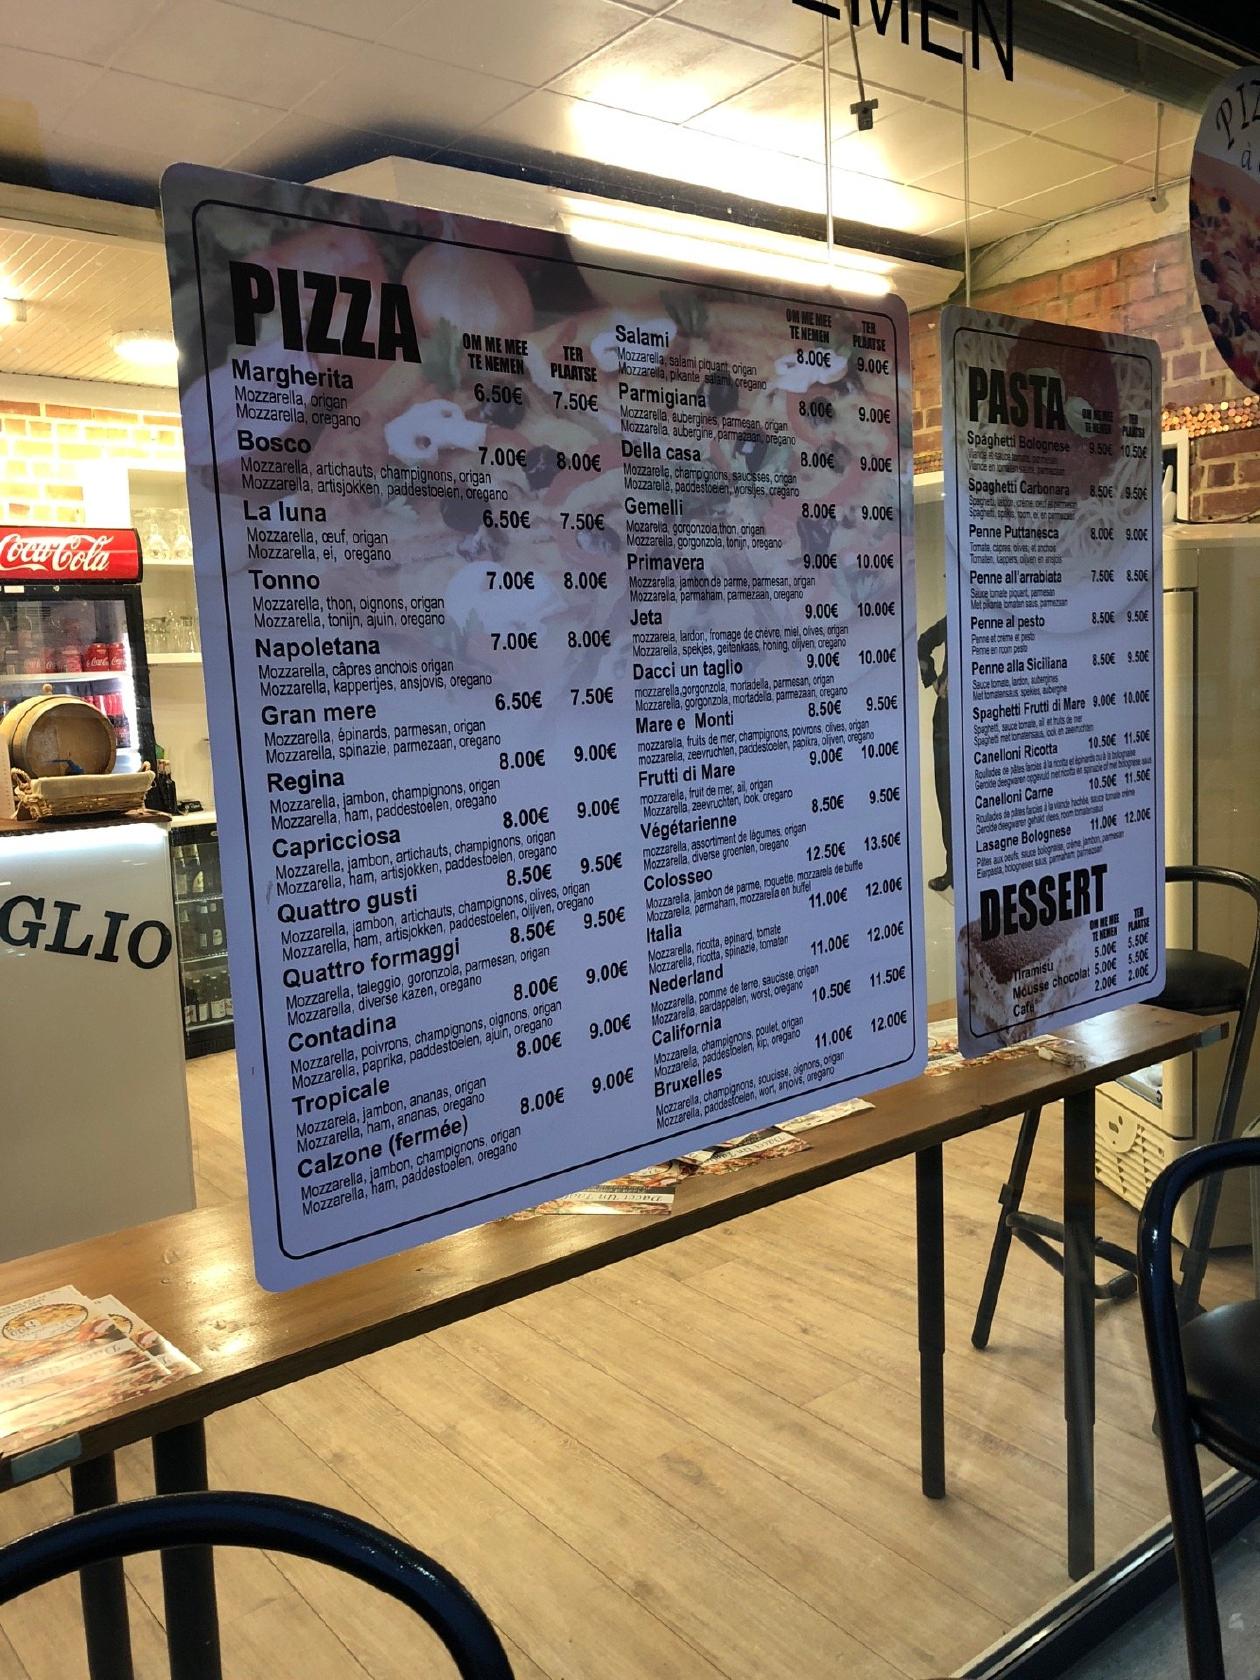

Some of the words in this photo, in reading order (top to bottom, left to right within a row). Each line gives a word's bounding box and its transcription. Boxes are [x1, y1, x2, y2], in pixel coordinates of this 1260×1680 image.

[229, 261, 422, 363] PIZZA
[462, 333, 482, 350] OM
[485, 336, 502, 353] ME
[505, 339, 528, 356] MEE
[616, 325, 669, 348] Salami
[468, 354, 482, 370] TE
[485, 356, 524, 374] NEMEN
[563, 346, 583, 362] TER
[796, 348, 831, 368] 8.00€
[857, 357, 889, 375] 9.00€
[232, 359, 353, 389] Margherita
[550, 363, 597, 382] PLAATSE
[474, 383, 522, 405] 6.50€
[553, 391, 598, 412] 7.50€
[619, 382, 706, 409] Parmigiana
[968, 366, 1066, 430] PASTA
[238, 430, 312, 453] Bosco
[622, 440, 660, 458] Della
[666, 446, 700, 461] casa
[968, 430, 1016, 448] Spaghetti
[478, 446, 527, 467] 7.00€
[556, 452, 601, 472] 8.00€
[968, 478, 1016, 496] Spaghetti
[1020, 480, 1070, 496] Carbonara
[244, 500, 271, 521] La
[279, 501, 327, 522] luna
[624, 496, 683, 515] Gemelli
[802, 503, 836, 519] 8.00€
[862, 505, 894, 520] 9.00€
[246, 527, 318, 544] Mozzarella,
[352, 530, 388, 548] origan
[969, 524, 1000, 538] Penne
[1004, 525, 1059, 540] Puttanesca
[627, 553, 704, 570] Primavera
[804, 554, 838, 569] 9.00€
[856, 554, 894, 569] 10.00€
[248, 570, 320, 590] Tonno
[486, 571, 534, 590] 7.00€
[563, 572, 608, 590] 8.00€
[970, 570, 1002, 584] Penne
[630, 609, 662, 626] Jeta
[970, 616, 1004, 630] Penne
[1006, 615, 1014, 628] al
[1018, 615, 1045, 631] pesto
[255, 636, 380, 662] Napoletana
[490, 632, 538, 650] 7.00€
[568, 630, 612, 648] 8.00€
[258, 662, 328, 680] Mozzarella,
[374, 660, 418, 676] anchois
[421, 659, 454, 675] origan
[633, 662, 676, 680] Dacci
[680, 664, 698, 677] un
[703, 659, 743, 678] taglio
[972, 661, 1004, 676] Penne
[1007, 659, 1024, 672] alla
[1026, 656, 1068, 670] Siciliana
[260, 680, 330, 697] Mozzarella,
[450, 674, 492, 690] oregano
[494, 690, 542, 710] 6.50€
[570, 687, 614, 706] 7.50€
[808, 700, 842, 718] 8.50€
[866, 695, 898, 712] 9.50€
[972, 702, 1020, 722] Spaghetti
[1024, 700, 1049, 715] Frutti
[1052, 700, 1061, 712] di
[1064, 697, 1086, 710] Mare
[1093, 693, 1116, 708] 9.00€
[1123, 690, 1150, 704] 10.00€
[261, 706, 316, 726] Gran
[324, 704, 376, 722] mere
[636, 718, 672, 734] Mare
[677, 718, 686, 730] e
[694, 710, 734, 728] Monti
[500, 749, 546, 770] 8.00€
[574, 743, 617, 762] 9.00€
[974, 748, 1021, 765] Canelloni
[1024, 743, 1058, 758] Ricotta
[267, 768, 345, 794] Regina
[638, 767, 678, 788] Frutti
[682, 766, 696, 782] di
[702, 763, 736, 780] Mare
[975, 788, 1022, 809] Canelloni
[1024, 786, 1054, 802] Carne
[640, 814, 737, 840] Végétarienne
[1090, 814, 1117, 830] 11.00€
[1124, 808, 1151, 824] 12.00€
[272, 828, 400, 859] Capricciosa
[806, 842, 846, 862] 12.50€
[864, 832, 901, 852] 13.50€
[976, 834, 1018, 853] Lasagne
[1022, 826, 1071, 844] Bolognese
[276, 859, 344, 880] Mozzarella,
[526, 830, 556, 846] origan
[506, 864, 552, 886] 8.50€
[580, 852, 622, 874] 9.50€
[644, 869, 712, 892] Colosseo
[278, 898, 360, 924] Quattro
[368, 884, 418, 914] gusti
[808, 888, 848, 908] 11.00€
[866, 877, 902, 898] 12.00€
[980, 864, 1108, 942] DESSERT
[646, 923, 682, 944] Italia
[1094, 942, 1116, 958] 5.00€
[282, 960, 365, 988] Quattro
[370, 937, 460, 970] formaggi
[514, 976, 558, 1000] 8.00€
[586, 960, 628, 984] 9.00€
[649, 963, 724, 995] Nederland
[1012, 981, 1049, 1000] Mousse
[1052, 967, 1090, 988] chocolat
[288, 1016, 397, 1052] Contadina
[652, 1016, 722, 1046] California
[814, 1025, 853, 1048] 11.00€
[870, 1010, 908, 1032] 12.00€
[520, 1087, 565, 1115] 8.00€
[592, 1067, 634, 1094] 9.00€
[654, 1067, 723, 1098] Bruxelles
[292, 1078, 390, 1116] Tropicale
[298, 1125, 363, 1153] Mozzarella,
[367, 1120, 394, 1135] ham,
[398, 1104, 440, 1126] ananas,
[443, 1092, 485, 1112] oregano
[298, 1143, 382, 1178] Calzone
[388, 1114, 468, 1157] (fermée)
